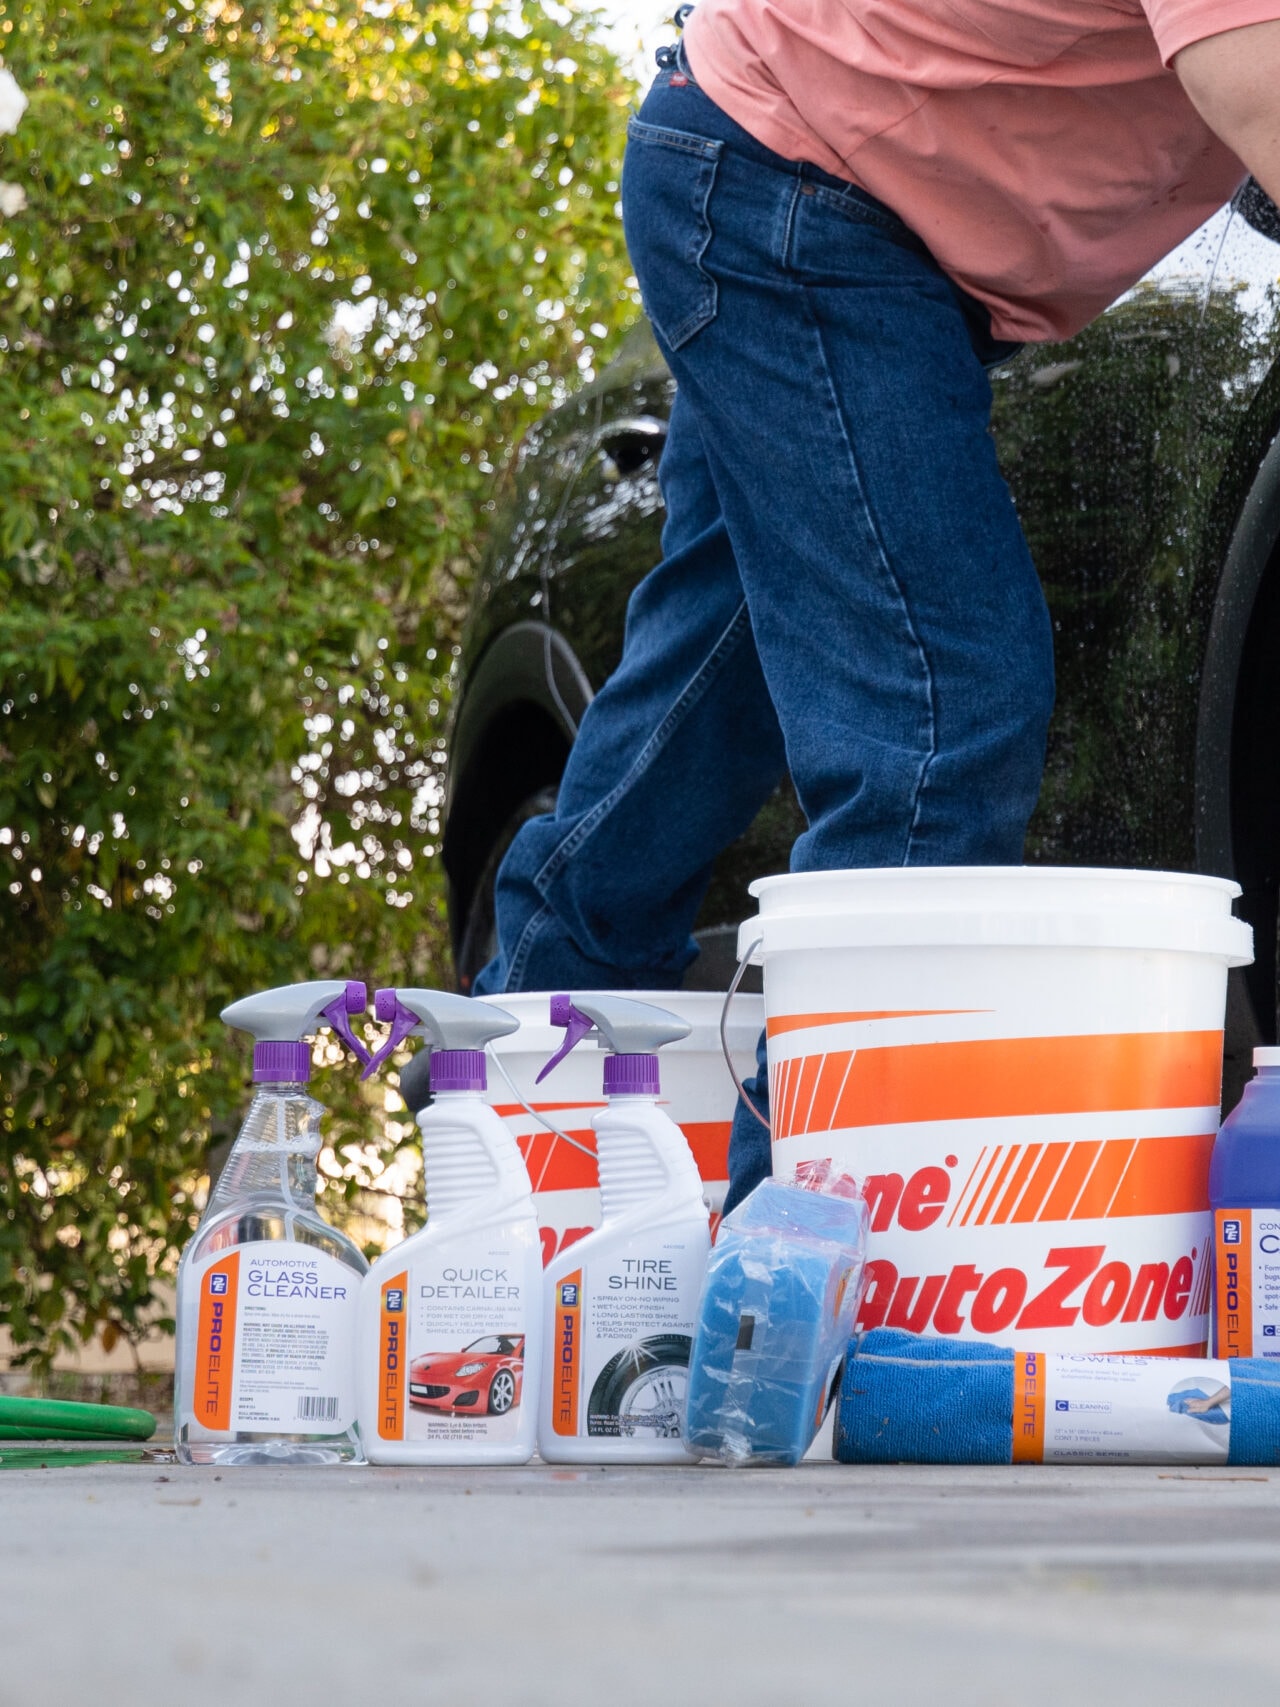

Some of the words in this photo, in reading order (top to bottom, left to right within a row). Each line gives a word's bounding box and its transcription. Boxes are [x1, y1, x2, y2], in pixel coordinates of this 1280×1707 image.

[250, 1259, 318, 1268] AUTOMOTIVE
[622, 1259, 672, 1273] TIRE
[248, 1270, 318, 1284] GLASS
[442, 1268, 508, 1282] QUICK
[608, 1275, 677, 1290] SHINE
[855, 1245, 1194, 1334] AutoZone
[247, 1284, 347, 1300] CLEANER
[420, 1285, 520, 1299] DETAILER
[1226, 1253, 1239, 1358] PROELIT
[1264, 1303, 1279, 1311] Safe
[206, 1302, 224, 1416] PROELITE
[1058, 1354, 1148, 1366] TOWELS
[385, 1321, 399, 1432] PROELITE
[560, 1315, 573, 1424] PROELITE
[1023, 1352, 1037, 1438] ROELITE
[1069, 1402, 1110, 1410] CLEANING
